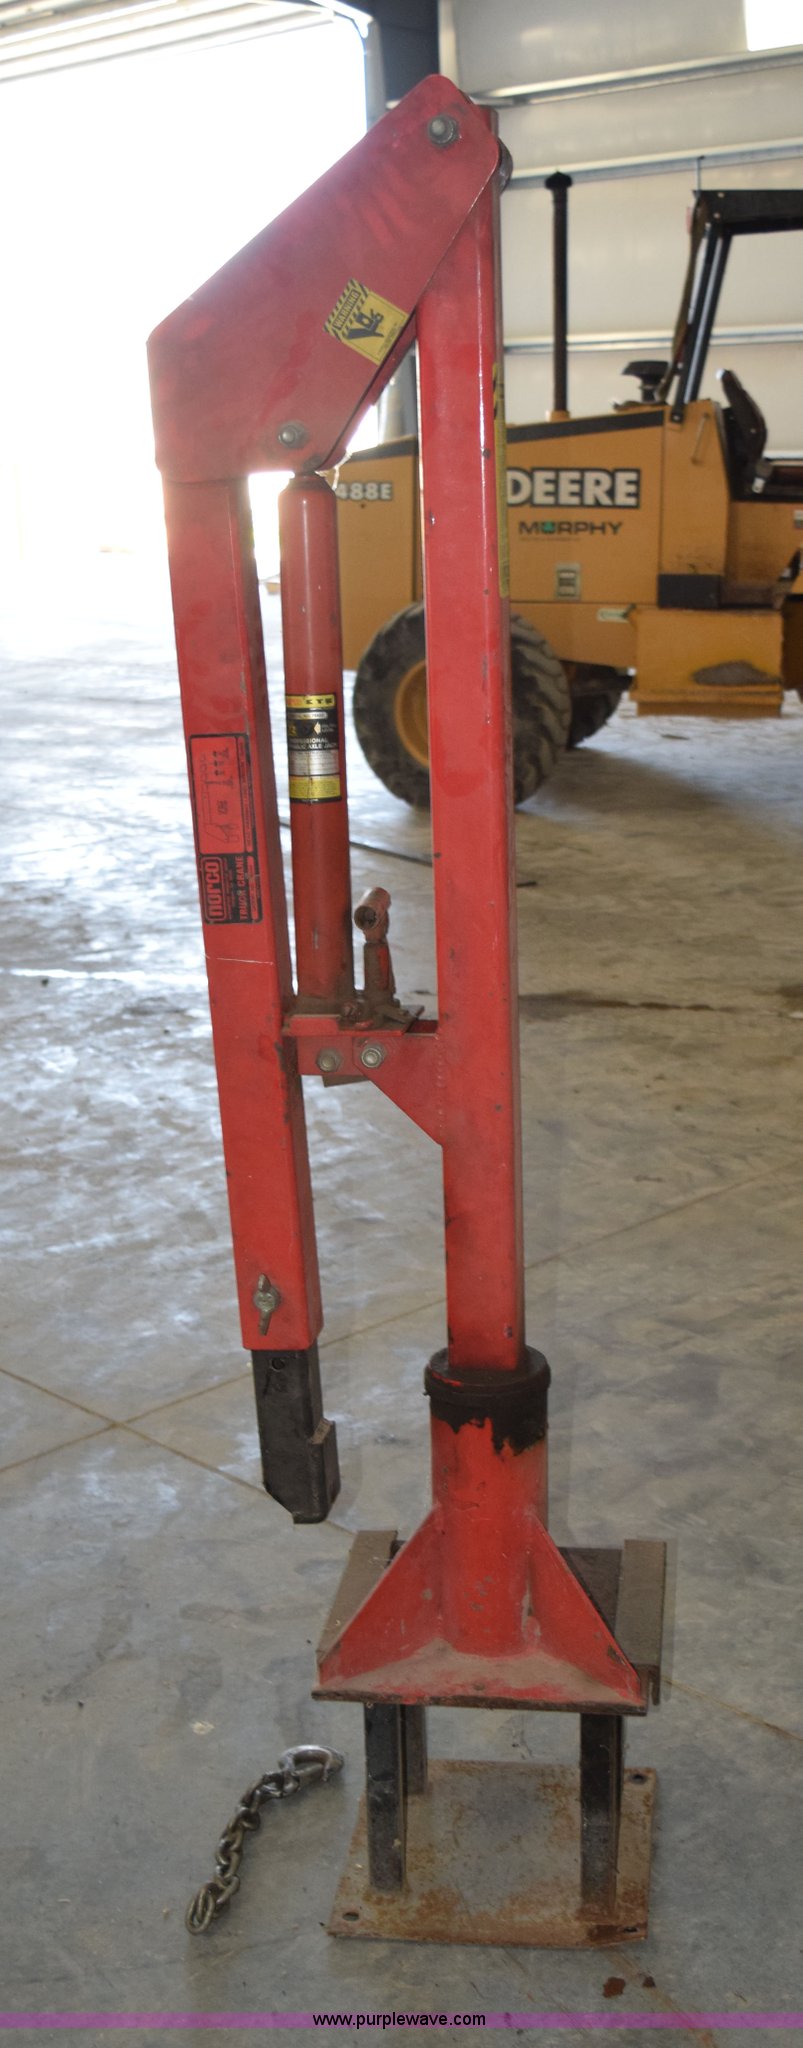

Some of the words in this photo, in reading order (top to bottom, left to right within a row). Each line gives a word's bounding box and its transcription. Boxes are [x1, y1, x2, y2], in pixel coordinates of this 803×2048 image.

[333, 290, 360, 329] WARNING
[335, 482, 392, 500] 488E
[507, 469, 640, 507] DEERE
[205, 861, 223, 916] norco
[235, 855, 247, 888] CRANE
[238, 889, 248, 920] TRUCK
